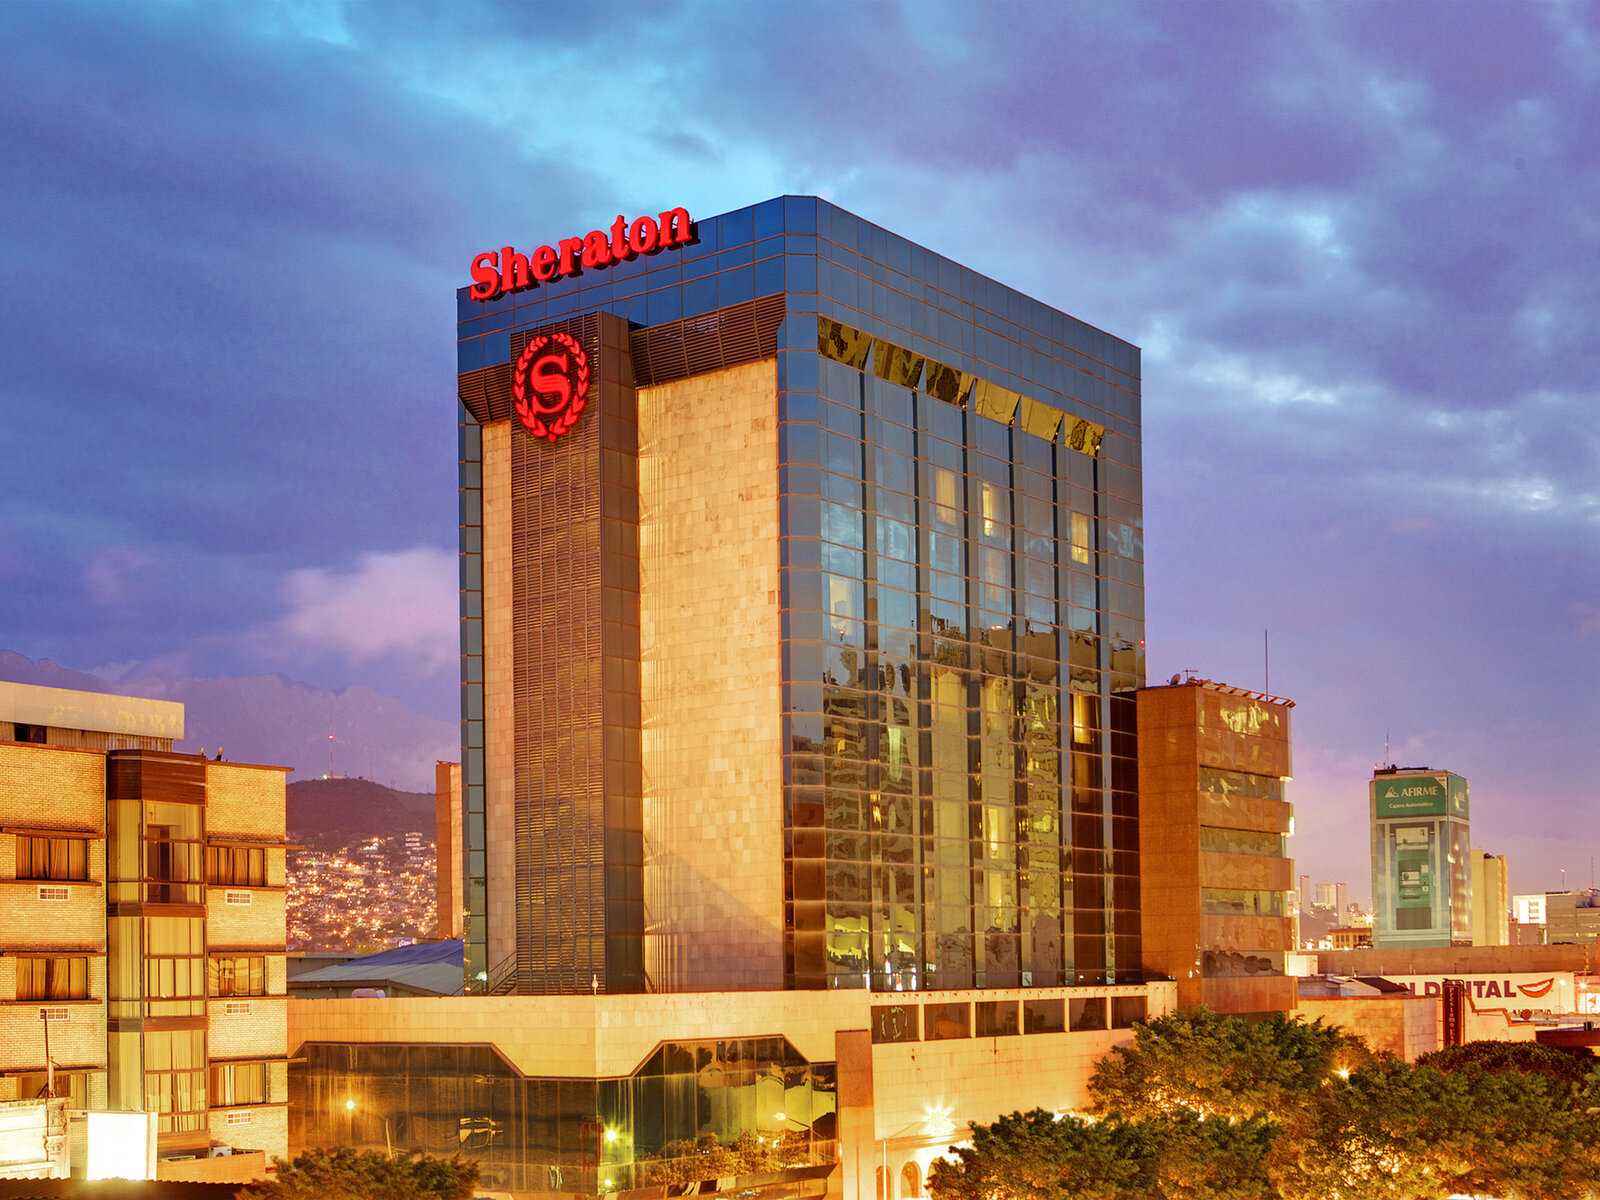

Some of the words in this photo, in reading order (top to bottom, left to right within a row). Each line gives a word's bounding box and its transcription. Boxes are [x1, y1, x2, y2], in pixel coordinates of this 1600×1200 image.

[469, 206, 693, 301] Sheraton
[530, 352, 571, 416] S
[1401, 786, 1438, 797] AFIRME
[1424, 980, 1517, 998] DTAL
